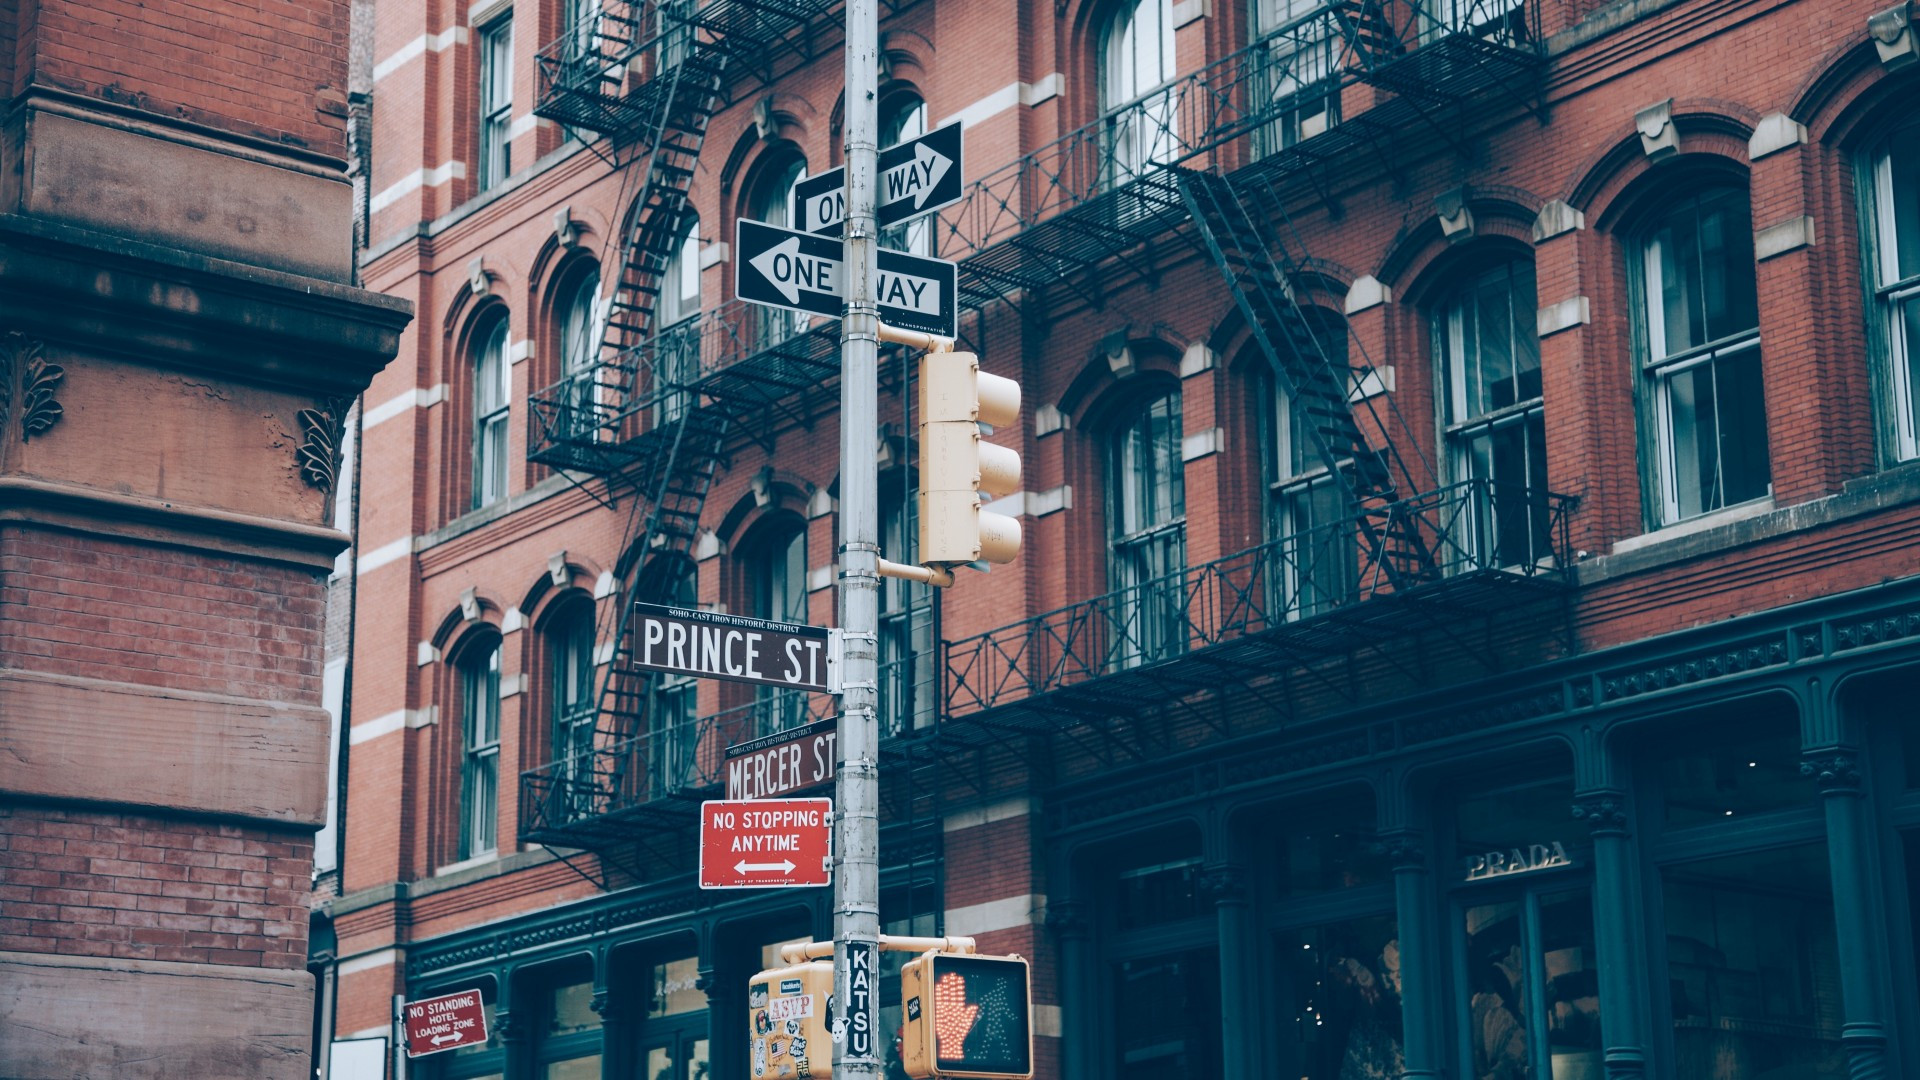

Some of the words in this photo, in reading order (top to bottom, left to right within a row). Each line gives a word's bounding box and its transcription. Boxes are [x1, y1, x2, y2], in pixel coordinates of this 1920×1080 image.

[818, 192, 845, 225] ON
[888, 156, 937, 200] WAY
[773, 252, 833, 292] ONE
[712, 614, 730, 624] IRON
[731, 617, 766, 628] HISTORIC
[767, 622, 800, 633] DISTRICT
[644, 618, 762, 679] PRINCE
[784, 638, 822, 686] ST
[729, 743, 802, 800] MERCER
[813, 732, 836, 782] ST
[713, 812, 735, 829] NO
[742, 810, 819, 829] STOPPING
[731, 834, 800, 853] ANYTIME
[1465, 841, 1571, 881] PRADA
[409, 1006, 424, 1018] NO
[427, 995, 474, 1015] STANDING
[770, 996, 810, 1020] ASVP
[853, 949, 869, 1053] KATSU
[415, 1023, 451, 1038] LOADING
[453, 1018, 475, 1030] ZONE
[428, 1012, 458, 1025] HOTEL
